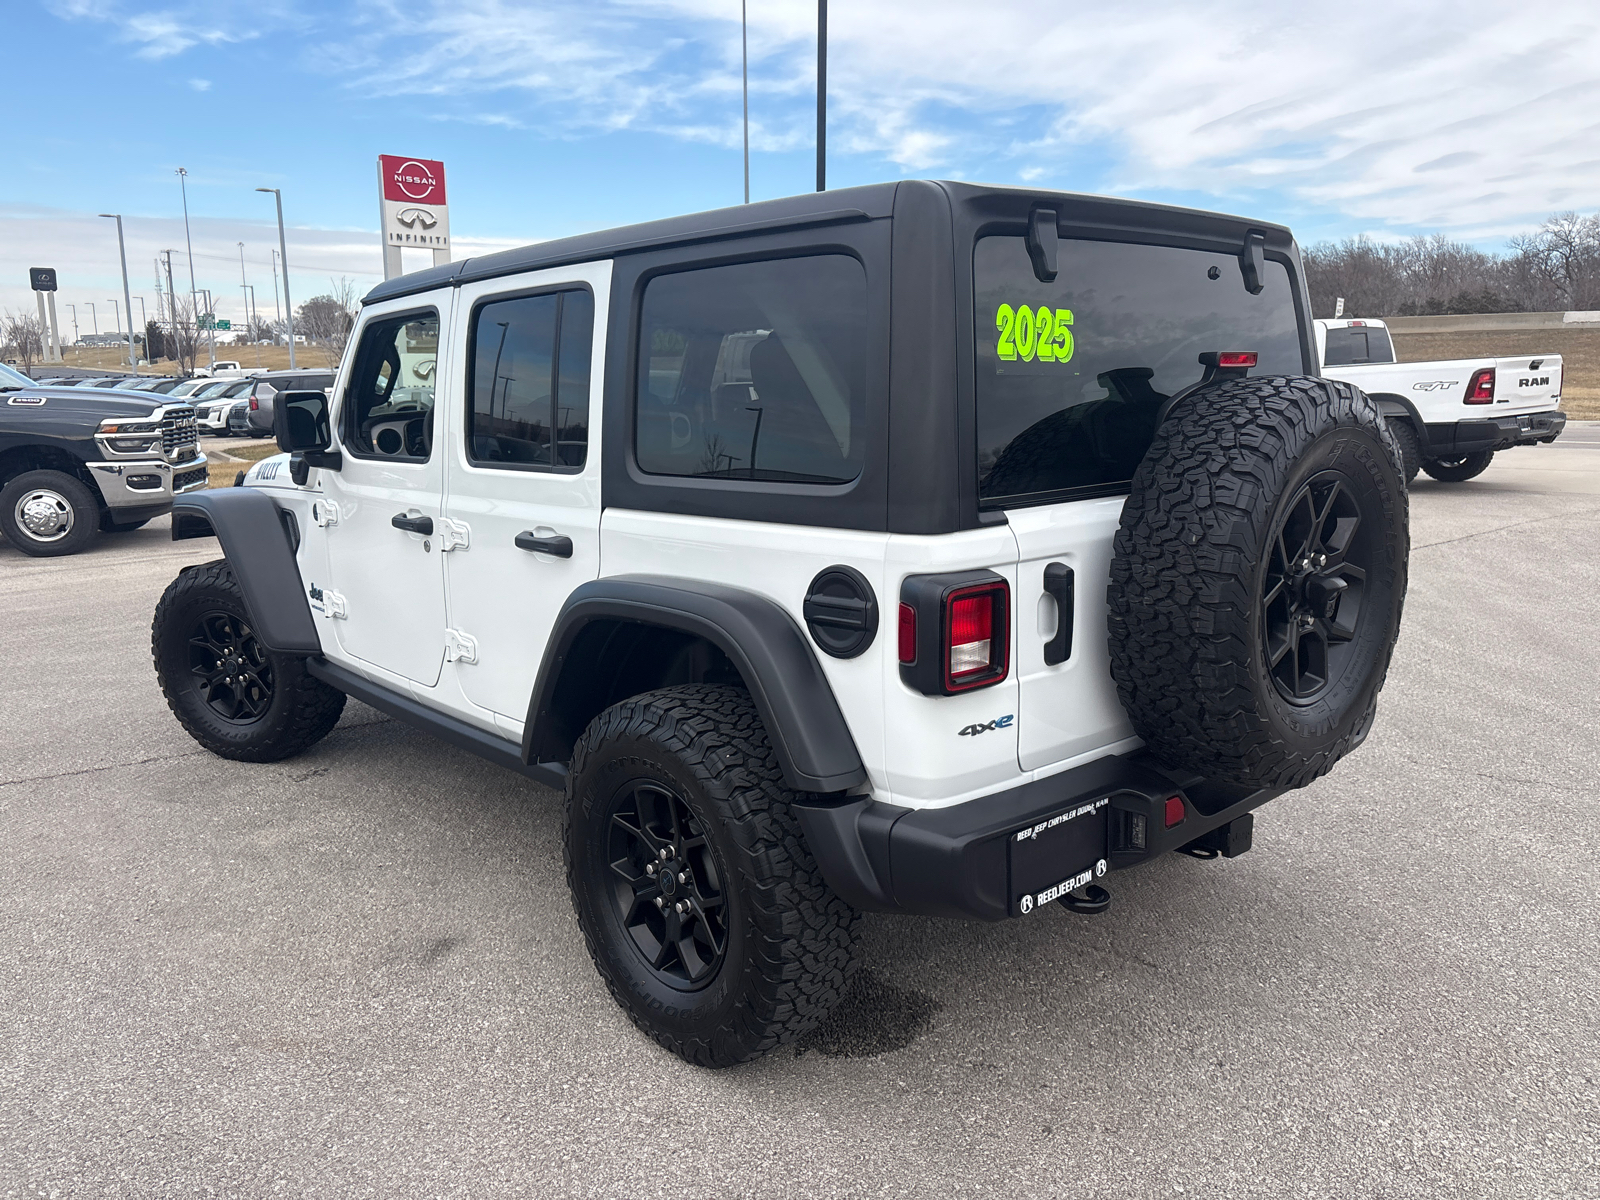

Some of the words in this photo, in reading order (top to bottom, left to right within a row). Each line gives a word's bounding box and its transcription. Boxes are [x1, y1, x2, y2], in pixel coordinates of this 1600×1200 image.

[394, 174, 436, 185] NISSAN
[390, 232, 447, 245] INFINITI
[996, 303, 1074, 363] 2025
[1518, 376, 1550, 388] RAM
[309, 582, 324, 602] Jee
[957, 714, 1014, 737] 4xe
[1017, 828, 1032, 841] REED
[1033, 822, 1047, 834] JEEP
[1048, 811, 1076, 828] CHRYSLER
[1096, 798, 1108, 808] RAM
[1037, 869, 1092, 907] REEDJEEP.COM
